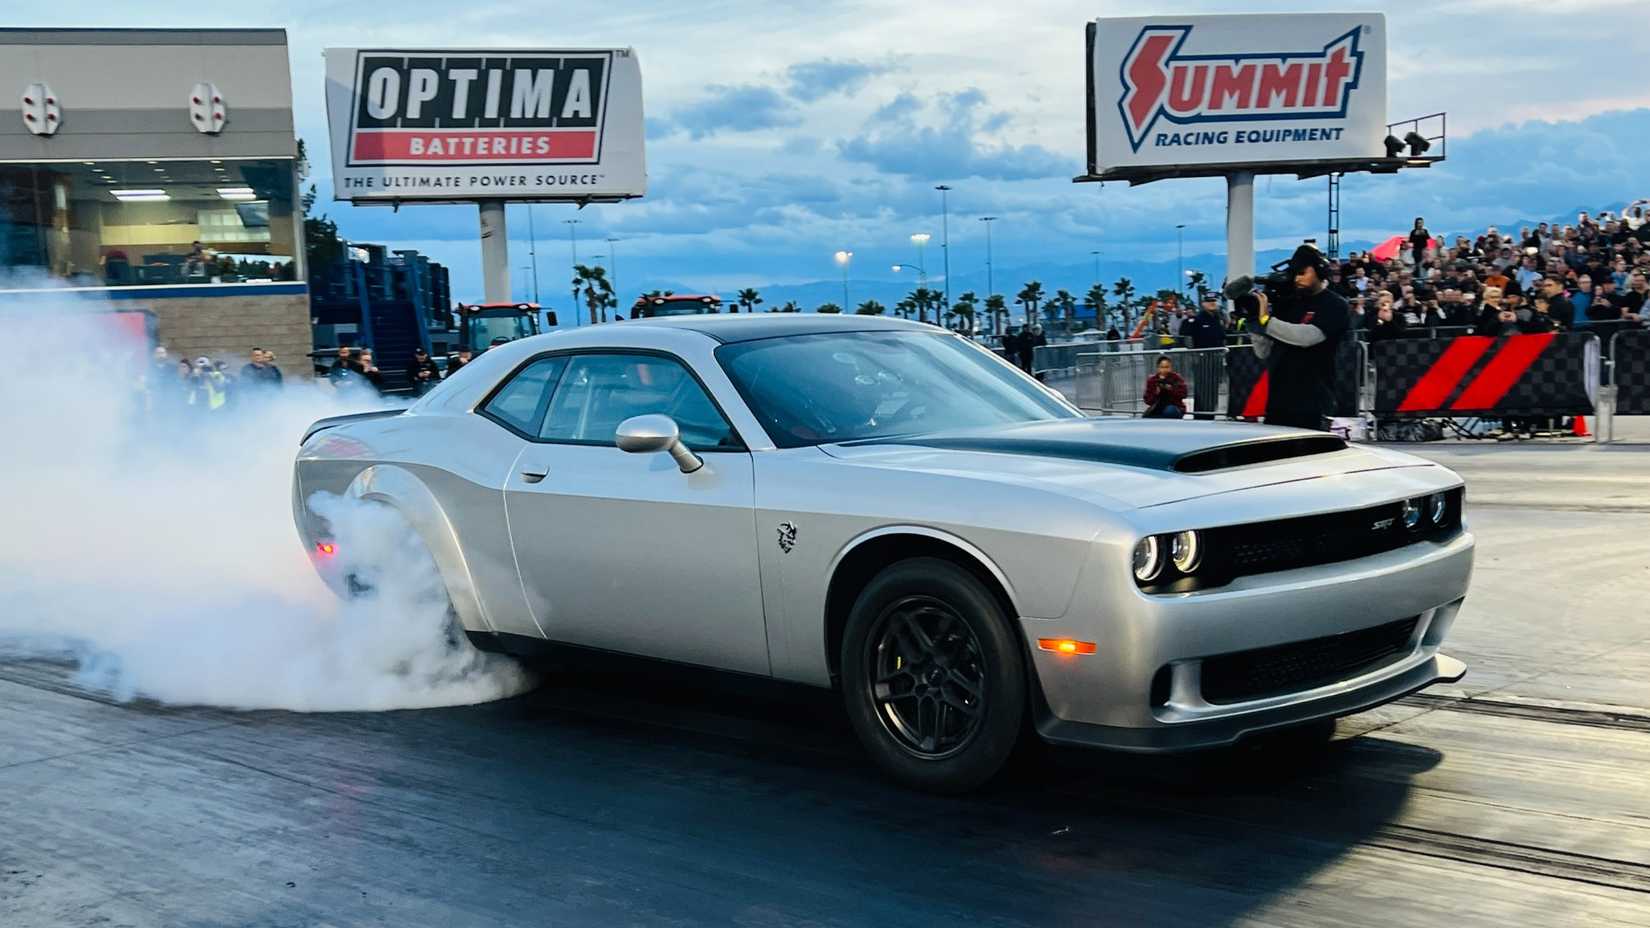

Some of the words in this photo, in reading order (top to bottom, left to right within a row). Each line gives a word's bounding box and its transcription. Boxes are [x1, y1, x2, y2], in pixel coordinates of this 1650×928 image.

[366, 67, 593, 120] OPTIMA
[409, 136, 551, 156] BATTERIES
[1155, 131, 1228, 147] RACING
[1234, 127, 1345, 144] EQUIPMENT
[345, 177, 373, 188] THE
[383, 176, 461, 188] ULTIMATE
[470, 175, 527, 187] POWER
